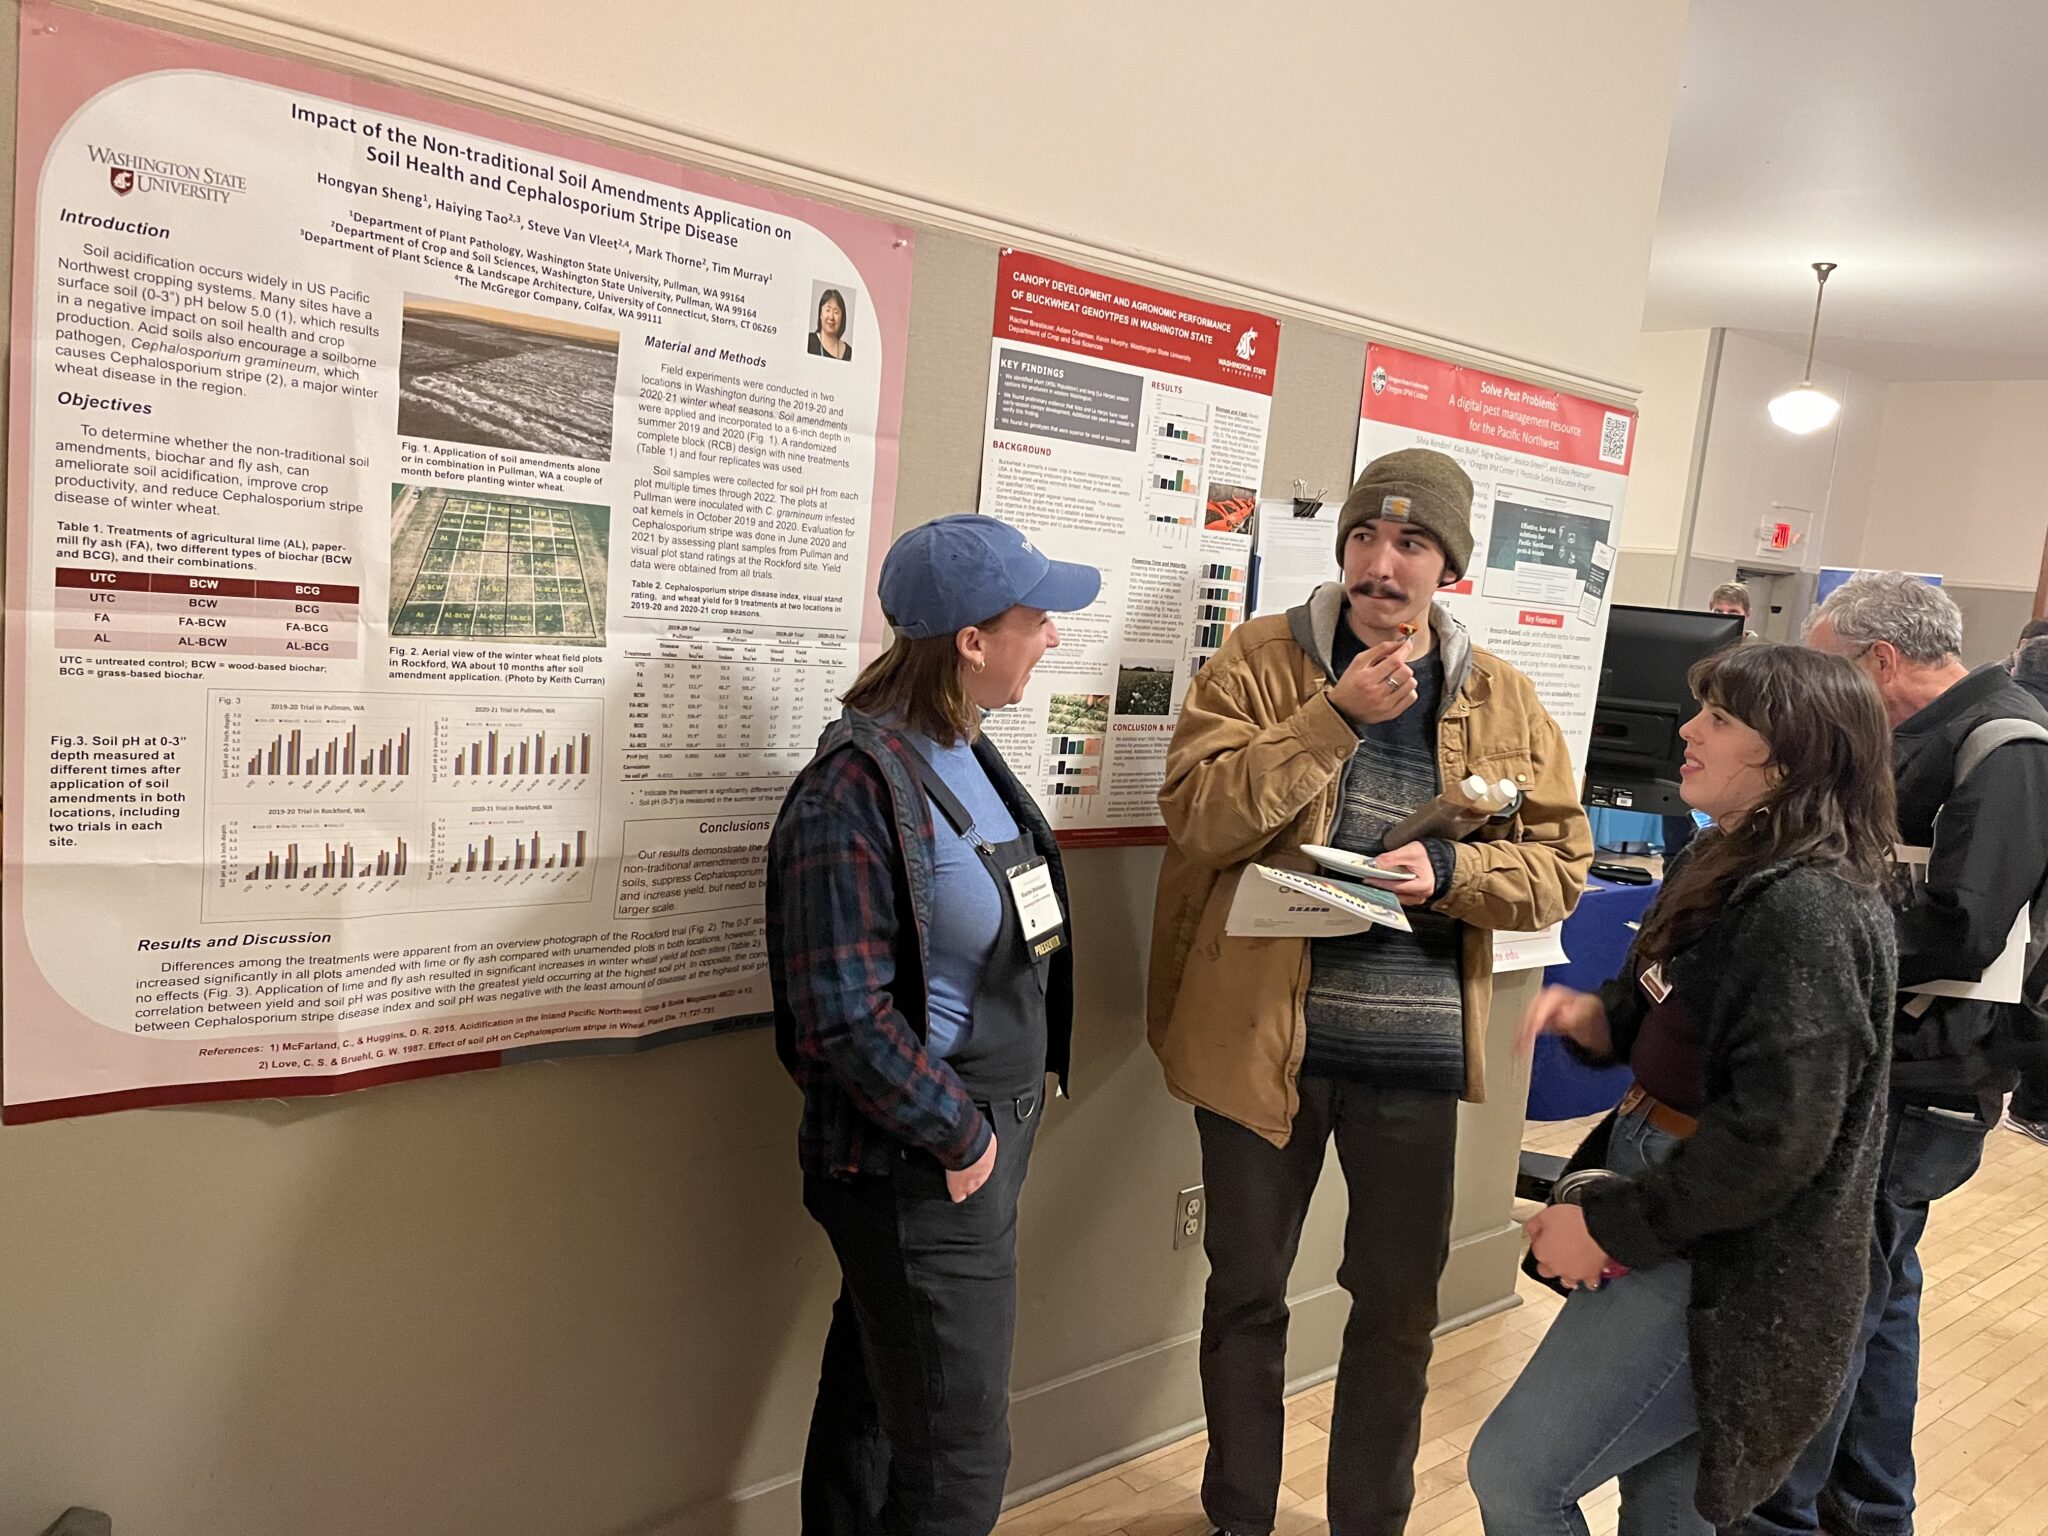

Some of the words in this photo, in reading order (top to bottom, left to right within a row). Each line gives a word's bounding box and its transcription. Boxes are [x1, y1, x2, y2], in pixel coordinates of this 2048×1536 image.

[87, 144, 201, 180] WASHINGTON
[203, 166, 247, 191] STATE
[292, 103, 356, 133] Impact
[362, 123, 382, 138] of
[386, 127, 416, 146] the
[423, 135, 553, 181] Non-traditional
[558, 169, 586, 189] Soil
[591, 178, 689, 215] Amendments
[693, 204, 770, 235] Application
[775, 227, 790, 240] on
[137, 175, 231, 204] UNIVERSITY
[366, 146, 399, 167] Soil
[406, 155, 463, 182] Health
[469, 173, 501, 190] and
[506, 179, 634, 223] Cephalosporium
[639, 212, 680, 234] Stripe
[685, 223, 737, 247] Disease
[60, 208, 169, 238] Introduction
[317, 172, 377, 195] Hongyan
[435, 198, 482, 221] Haiying
[527, 219, 559, 236] Steve
[563, 227, 585, 242] Van
[635, 244, 662, 260] Mark
[711, 261, 730, 274] Tim
[83, 243, 109, 258] Soil
[113, 250, 194, 272] acidification
[198, 265, 242, 280] occurs
[246, 272, 287, 290] widely
[291, 281, 302, 291] in
[307, 281, 325, 295] US
[330, 286, 369, 303] Pacific
[480, 280, 530, 298] McGregor
[533, 291, 581, 309] Company,
[584, 301, 615, 316] Colfax,
[618, 307, 634, 318] WA
[636, 311, 661, 324] 99111
[1012, 271, 1050, 287] CANOPY
[1051, 279, 1112, 302] DEVELOPMENT
[1112, 295, 1130, 307] AND
[1131, 300, 1177, 319] AGRONOMIC
[1178, 311, 1231, 332] PERFORMANCE
[1011, 289, 1024, 299] OF
[1026, 292, 1080, 312] BUCKWHEAT
[1130, 317, 1138, 327] IN
[1140, 319, 1189, 339] WASHINGTON
[1190, 331, 1213, 344] STATE
[644, 335, 691, 353] Material
[694, 347, 716, 358] and
[718, 349, 766, 367] Methods
[1000, 356, 1018, 369] KEY
[1021, 362, 1064, 378] FINDINGS
[1152, 381, 1183, 394] RESULTS
[1480, 381, 1502, 397] Solve
[1503, 387, 1520, 402] Pest
[1521, 391, 1558, 411] Problems:
[57, 391, 152, 414] Objectives
[1448, 394, 1455, 406] A
[1456, 396, 1482, 412] digital
[1482, 404, 1500, 416] pest
[1501, 409, 1550, 428] management
[1550, 420, 1581, 436] resource
[80, 423, 97, 436] To
[101, 426, 170, 444] determine
[174, 436, 228, 451] whether
[232, 441, 252, 454] the
[256, 446, 345, 464] non-traditional
[349, 456, 369, 467] soil
[992, 440, 1052, 456] BACKGROUND
[1469, 418, 1481, 432] for
[1482, 422, 1495, 436] the
[1496, 425, 1520, 441] Pacific
[1521, 431, 1559, 450] Northwest
[401, 441, 419, 453] Fig.
[423, 444, 430, 453] 1.
[433, 445, 486, 459] Application
[488, 453, 498, 461] of
[500, 455, 517, 463] soil
[519, 457, 575, 470] amendments
[577, 464, 600, 473] alone
[56, 520, 89, 532] Table
[93, 524, 103, 533] 1.
[106, 524, 172, 538] Treatments
[176, 530, 188, 539] of
[190, 532, 254, 544] agricultural
[258, 536, 280, 546] lime
[283, 539, 308, 550] (AL),
[90, 572, 117, 584] UTC
[189, 578, 219, 590] BCW
[295, 585, 320, 596] BCG
[90, 592, 116, 604] UTC
[188, 598, 218, 609] BCW
[295, 604, 320, 614] BCG
[630, 601, 662, 610] 2019-20
[680, 604, 708, 613] 2020-21
[710, 608, 728, 616] crop
[729, 609, 761, 617] seasons.
[94, 612, 110, 623] FA
[179, 617, 227, 628] FA-BCW
[286, 622, 329, 633] FA-BCG
[94, 632, 111, 643] AL
[178, 636, 227, 647] AL-BCW
[286, 642, 329, 652] AL-BCG
[389, 646, 407, 657] Fig.
[410, 647, 419, 655] 2.
[421, 648, 449, 656] Aerial
[452, 649, 474, 657] view
[476, 650, 486, 658] of
[488, 651, 502, 659] the
[504, 652, 532, 660] winter
[534, 653, 560, 661] wheat
[562, 653, 580, 662] field
[582, 655, 602, 663] plots
[51, 735, 87, 747] Fig.3.
[92, 736, 117, 745] Soil
[122, 736, 140, 748] pH
[144, 737, 156, 745] at
[160, 736, 186, 746] 0-3"
[1113, 724, 1157, 732] CONCLUSION
[50, 750, 88, 762] depth
[93, 750, 158, 760] measured
[163, 751, 174, 760] at
[50, 764, 107, 774] different
[111, 764, 146, 774] times
[151, 764, 180, 774] after
[700, 822, 770, 834] Conclusions
[137, 937, 201, 951] Results
[206, 934, 238, 947] and
[242, 931, 331, 945] Discussion
[161, 960, 234, 972] Differences
[238, 958, 281, 968] among
[285, 955, 305, 965] the
[309, 952, 369, 965] treatments
[373, 950, 399, 959] were
[402, 945, 450, 958] apparent
[453, 943, 477, 952] from
[496, 939, 540, 949] overview
[543, 933, 597, 946] photograph
[198, 1046, 264, 1058] References:
